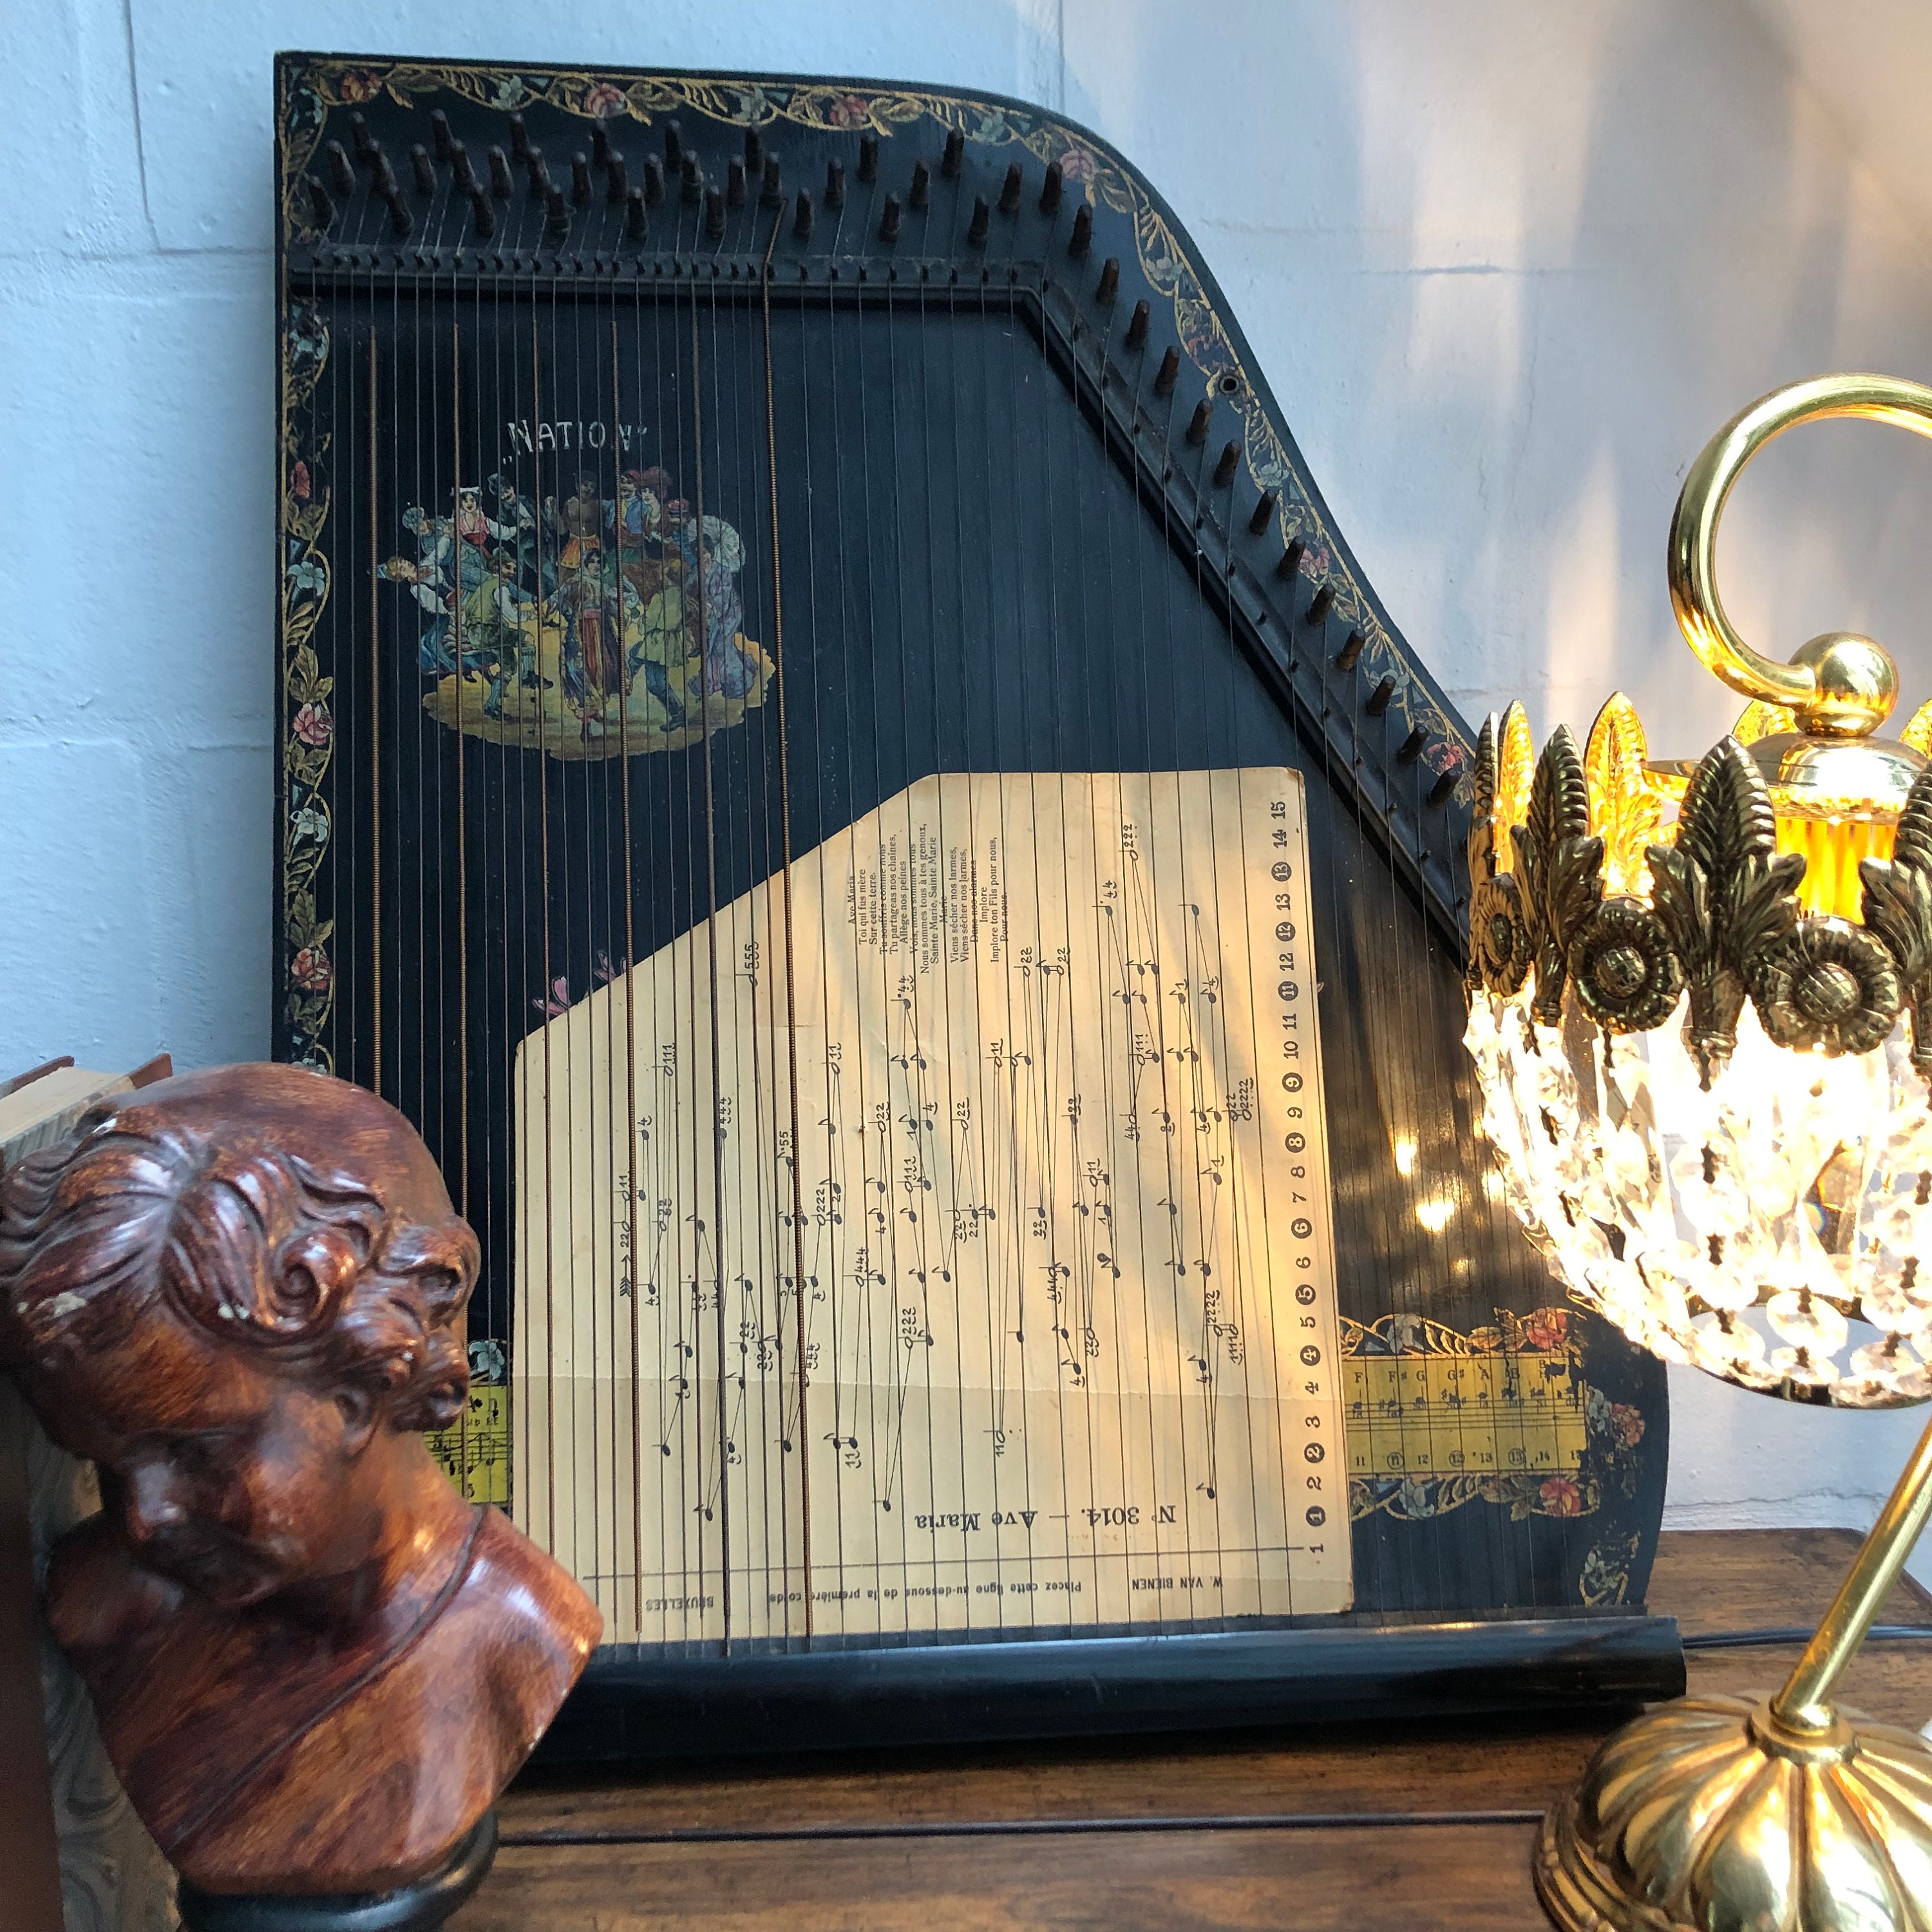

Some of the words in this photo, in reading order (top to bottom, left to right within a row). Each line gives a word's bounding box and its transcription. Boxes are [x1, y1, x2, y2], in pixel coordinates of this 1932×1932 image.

[1271, 800, 1285, 819] 15
[1124, 824, 1133, 847] 222
[1273, 829, 1287, 848] 14
[928, 837, 936, 864] Marie
[899, 860, 909, 889] peines
[929, 867, 937, 897] Sainte
[990, 864, 998, 885] pour
[858, 896, 866, 909] fus
[980, 886, 989, 922] Implore
[989, 888, 998, 905] Fils
[1276, 893, 1291, 910] 13
[858, 912, 868, 925] qui
[888, 892, 900, 938] partageas
[858, 929, 867, 943] Toi
[869, 927, 877, 943] Sur
[900, 913, 909, 943] Allège
[890, 941, 898, 954] Tu
[990, 927, 1000, 961] Implore
[1280, 952, 1294, 971] 12
[1282, 1012, 1296, 1029] 11
[1283, 1040, 1299, 1059] 10
[876, 1103, 884, 1119] 22
[958, 1101, 965, 1115] 22
[1287, 1106, 1303, 1118] 9
[904, 1158, 913, 1179] 111
[1291, 1165, 1305, 1178] 8
[620, 1175, 627, 1187] 11
[1293, 1191, 1307, 1202] 7
[969, 1220, 978, 1237] 22
[621, 1233, 629, 1247] 22
[855, 1246, 864, 1272] 444
[1296, 1256, 1311, 1268] 6
[902, 1307, 911, 1334] 222
[1301, 1316, 1316, 1327] 5
[1305, 1381, 1318, 1394] 4
[1306, 1416, 1320, 1427] 3
[1356, 1456, 1365, 1466] 11
[1307, 1475, 1321, 1489] 2
[914, 1513, 980, 1532] Maria
[991, 1510, 1037, 1529] Ave
[1080, 1506, 1139, 1526] 3014.
[1311, 1542, 1323, 1552] 1
[1132, 1578, 1172, 1589] BIENEN
[1180, 1577, 1202, 1588] VAN
[884, 1588, 896, 1599] de
